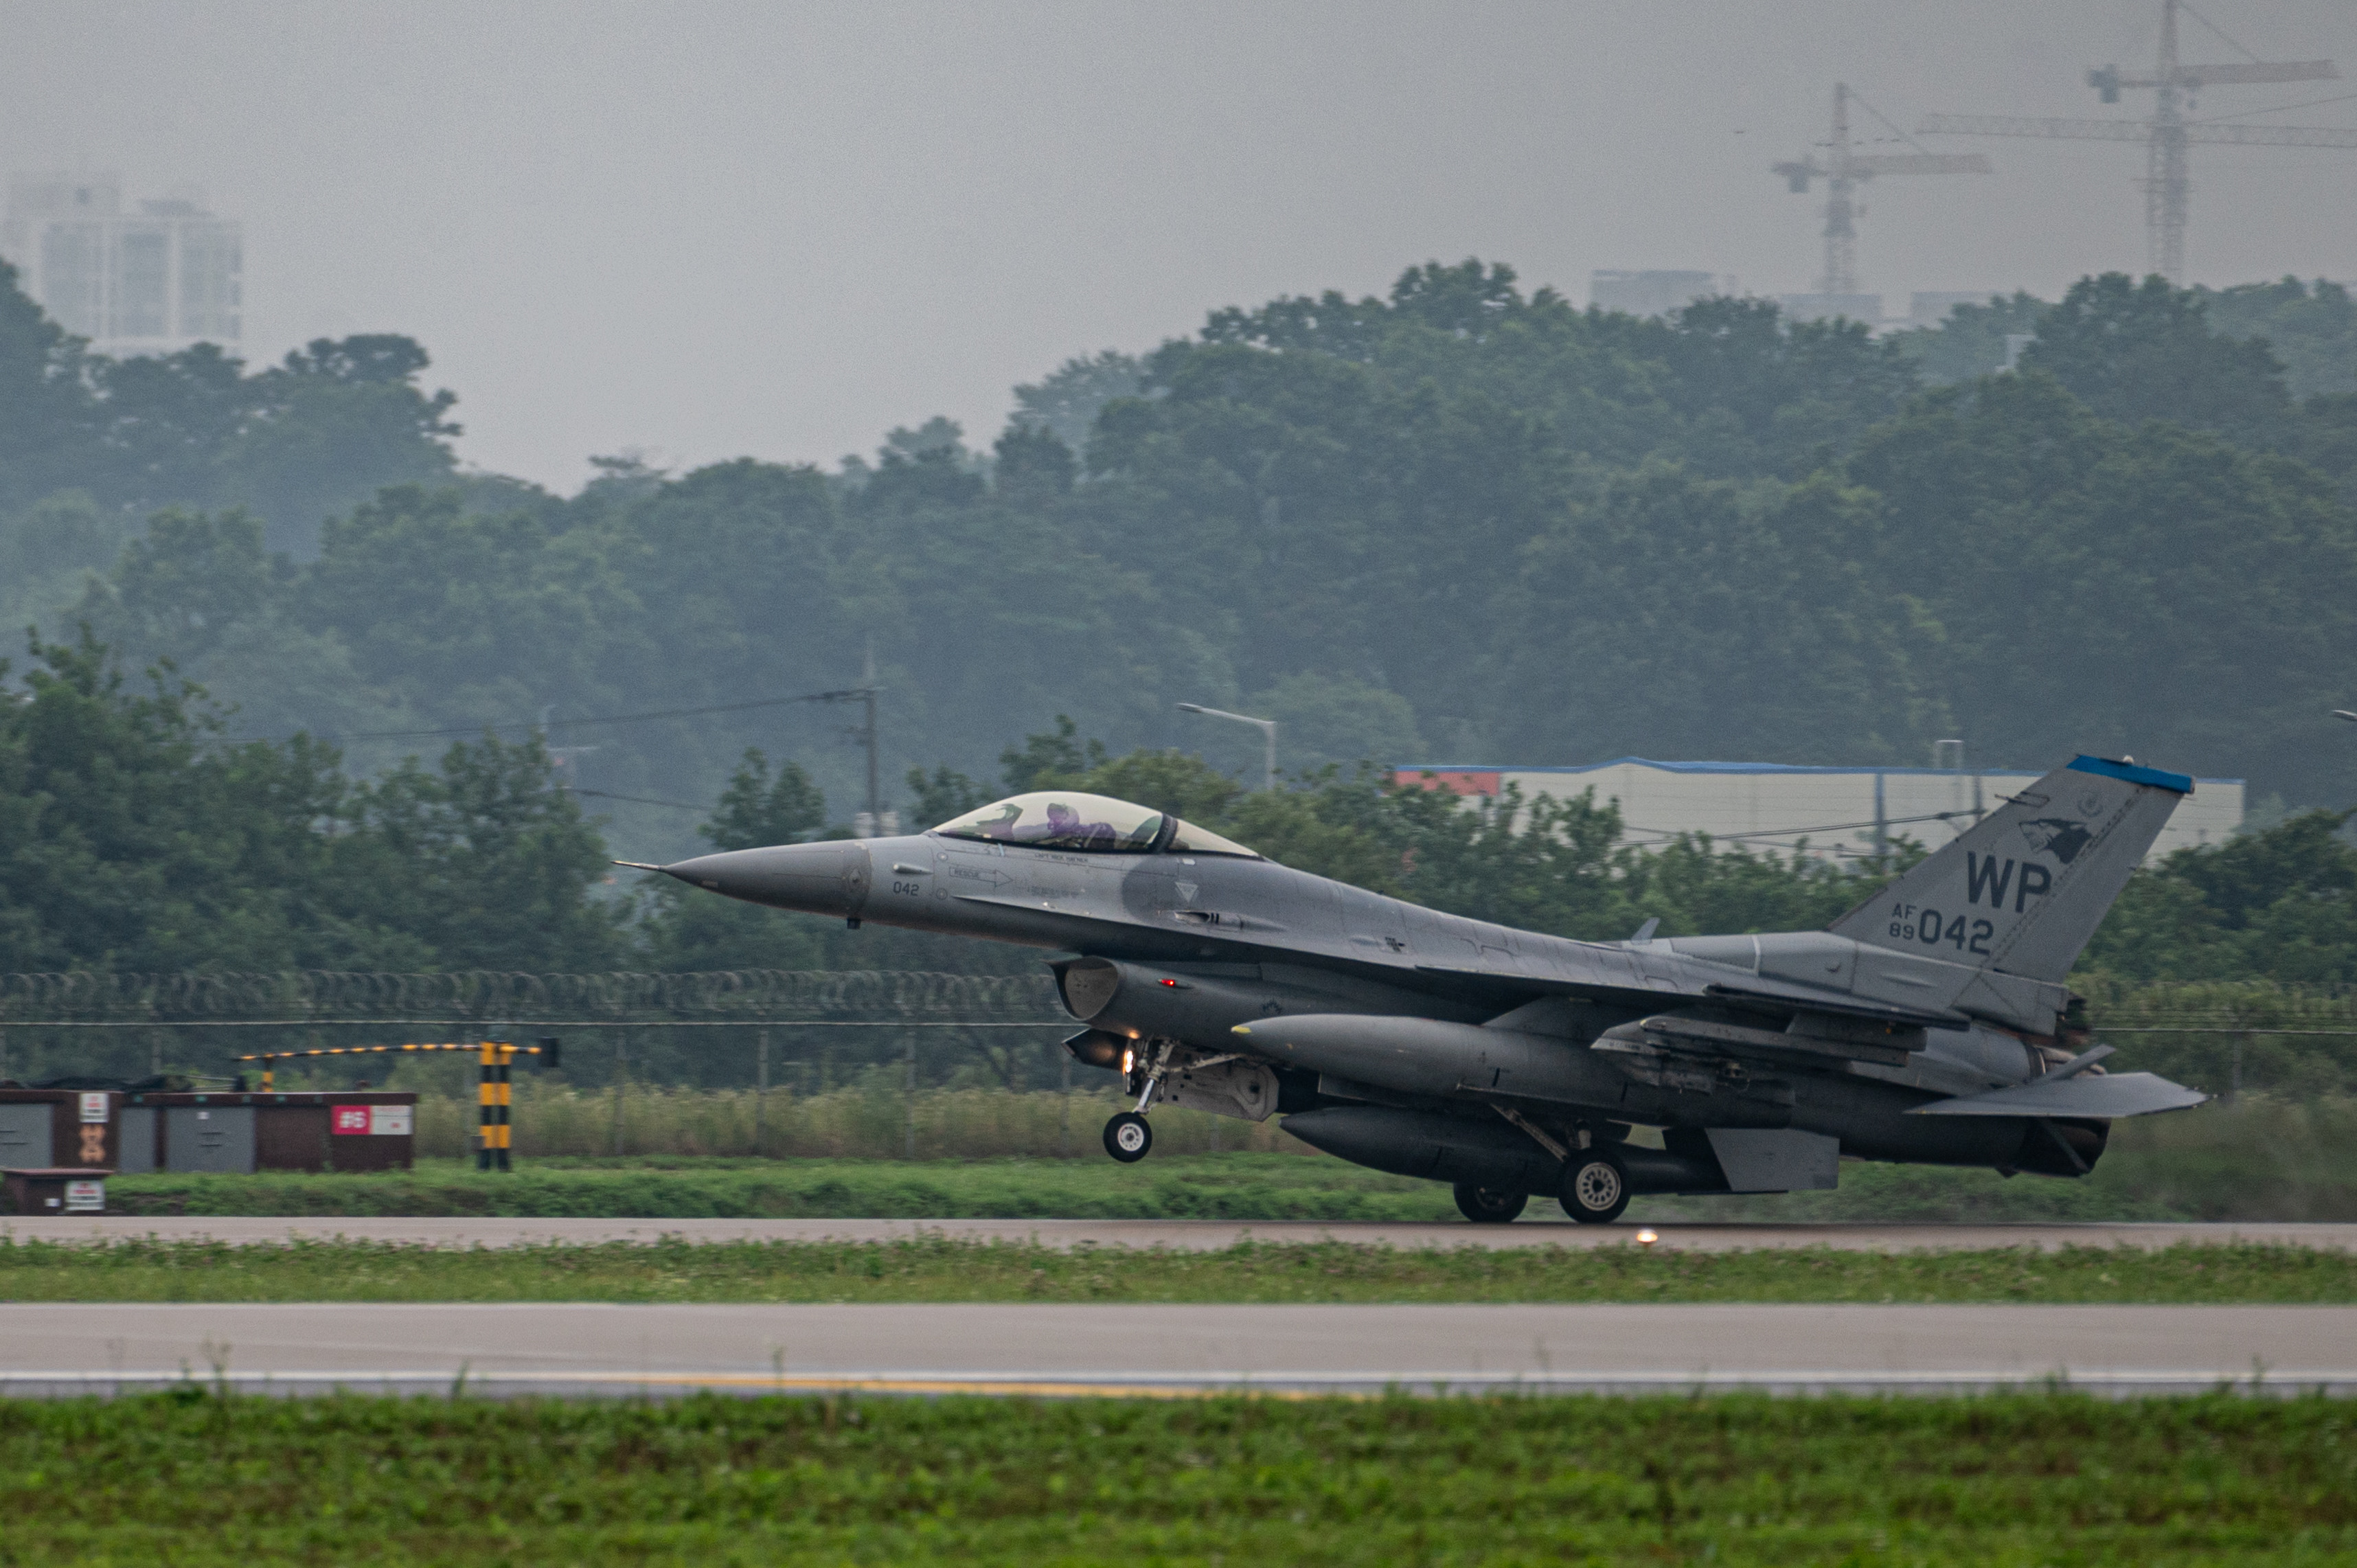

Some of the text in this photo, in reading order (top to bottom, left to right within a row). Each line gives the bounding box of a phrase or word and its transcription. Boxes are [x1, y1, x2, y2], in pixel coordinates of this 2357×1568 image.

[893, 881, 920, 896] 042
[1968, 850, 2052, 913] WP
[1892, 902, 1917, 920] AF
[1889, 909, 1994, 956] 89 042
